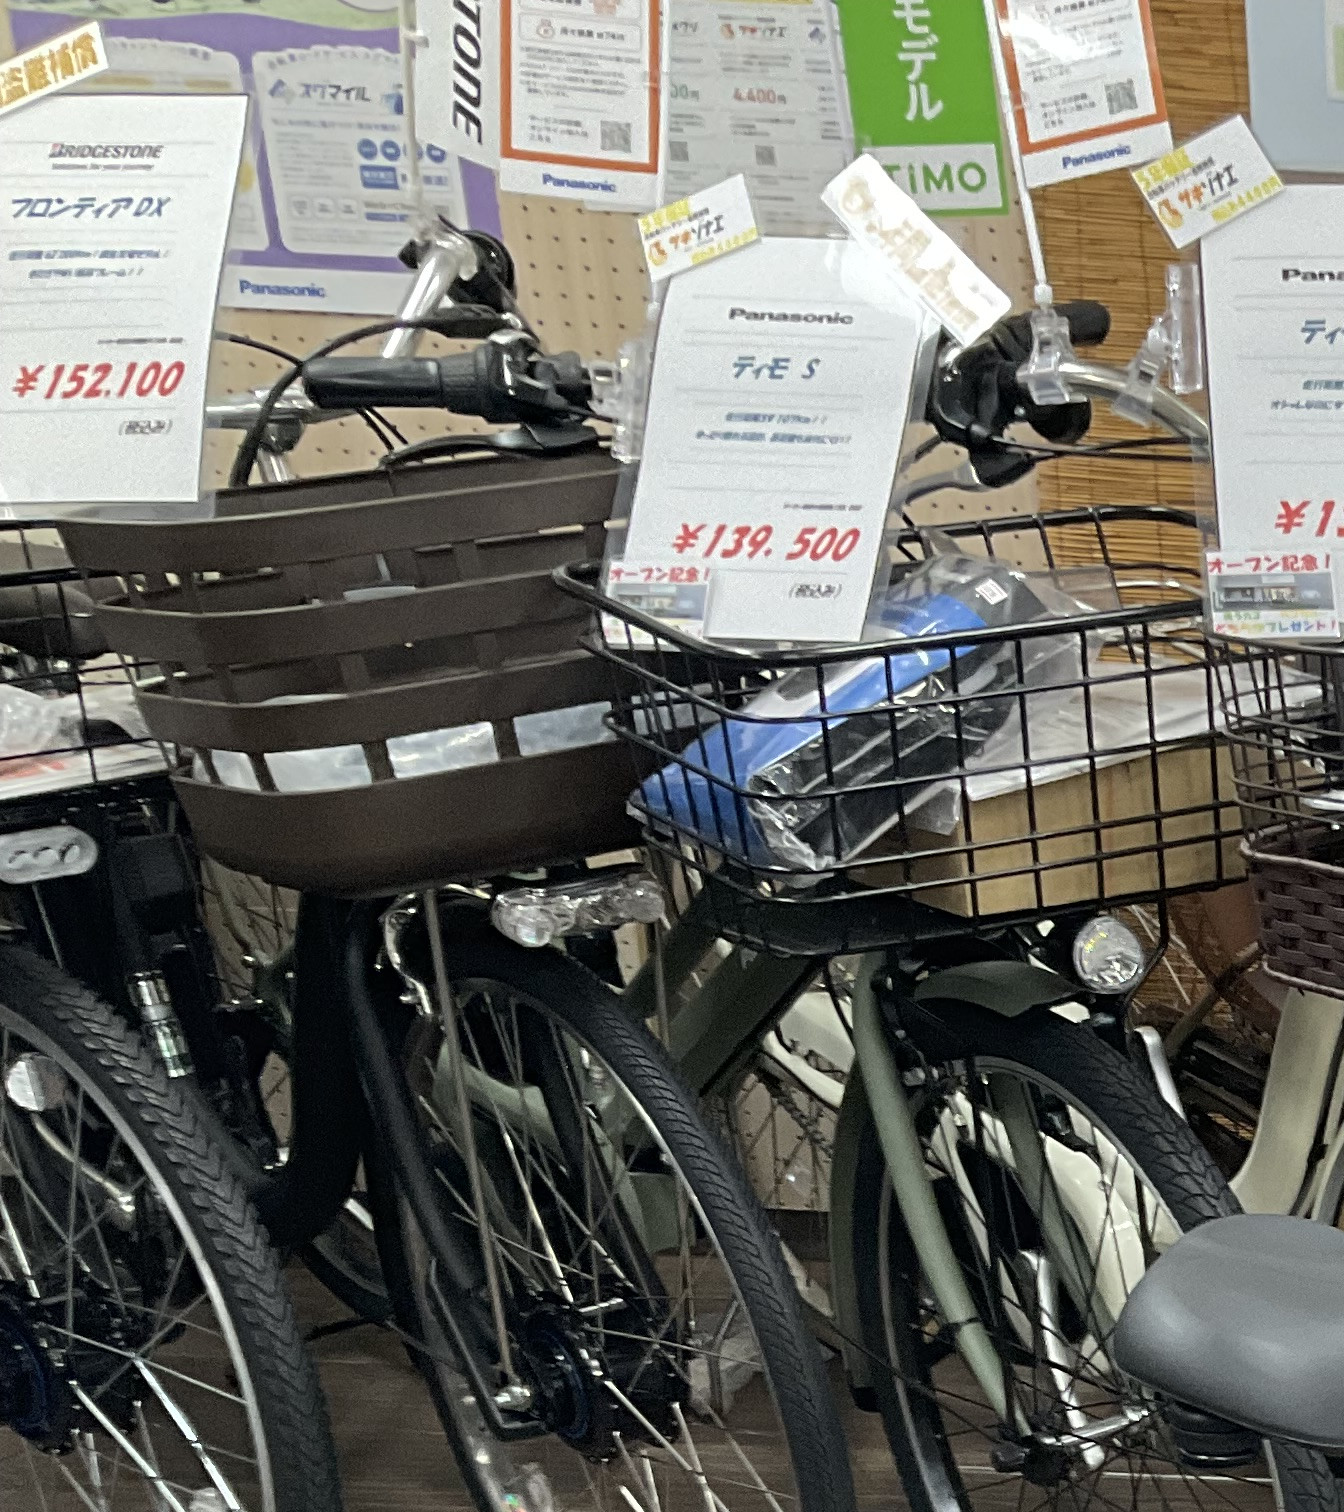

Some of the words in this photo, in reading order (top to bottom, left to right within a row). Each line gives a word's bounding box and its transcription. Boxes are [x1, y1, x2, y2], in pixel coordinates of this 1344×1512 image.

[49, 142, 165, 159] BRIDGESTONE
[1061, 143, 1132, 169] Panasonic
[542, 173, 617, 193] Panasonic
[238, 279, 327, 298] Panasonic
[728, 306, 854, 325] Panasonic
[732, 356, 791, 380] ティモ
[801, 357, 822, 380] S
